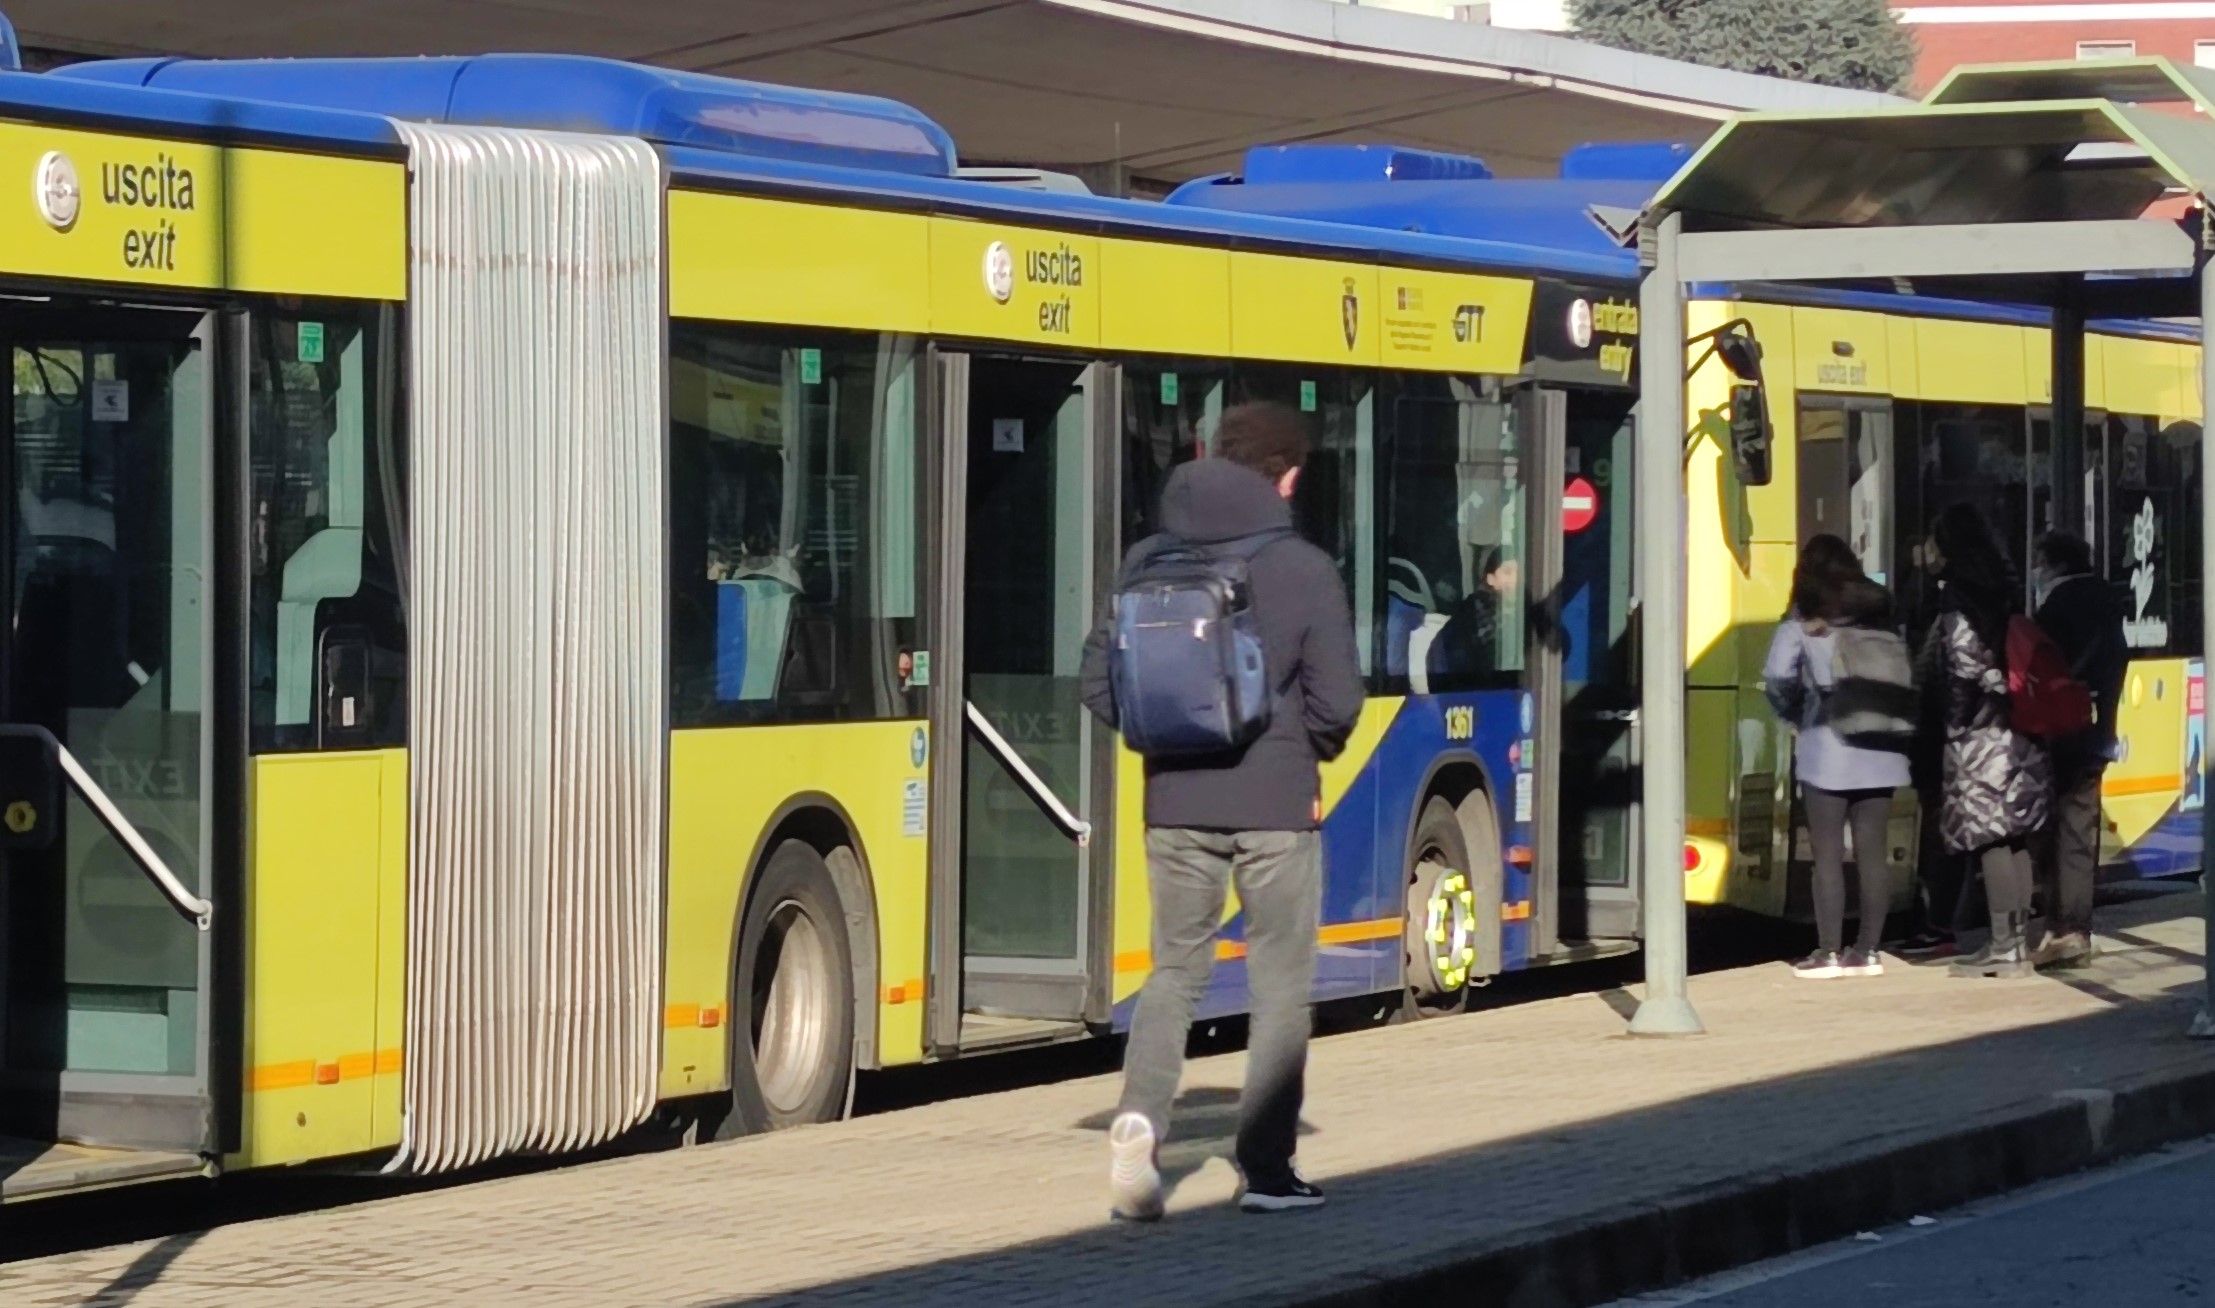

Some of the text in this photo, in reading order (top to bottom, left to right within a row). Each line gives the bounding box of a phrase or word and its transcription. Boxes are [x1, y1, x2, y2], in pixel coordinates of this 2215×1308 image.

[102, 152, 194, 210] uscita
[123, 218, 176, 271] exit
[1026, 241, 1081, 286] uscita
[1039, 293, 1070, 334] exit
[1453, 304, 1485, 343] GTT
